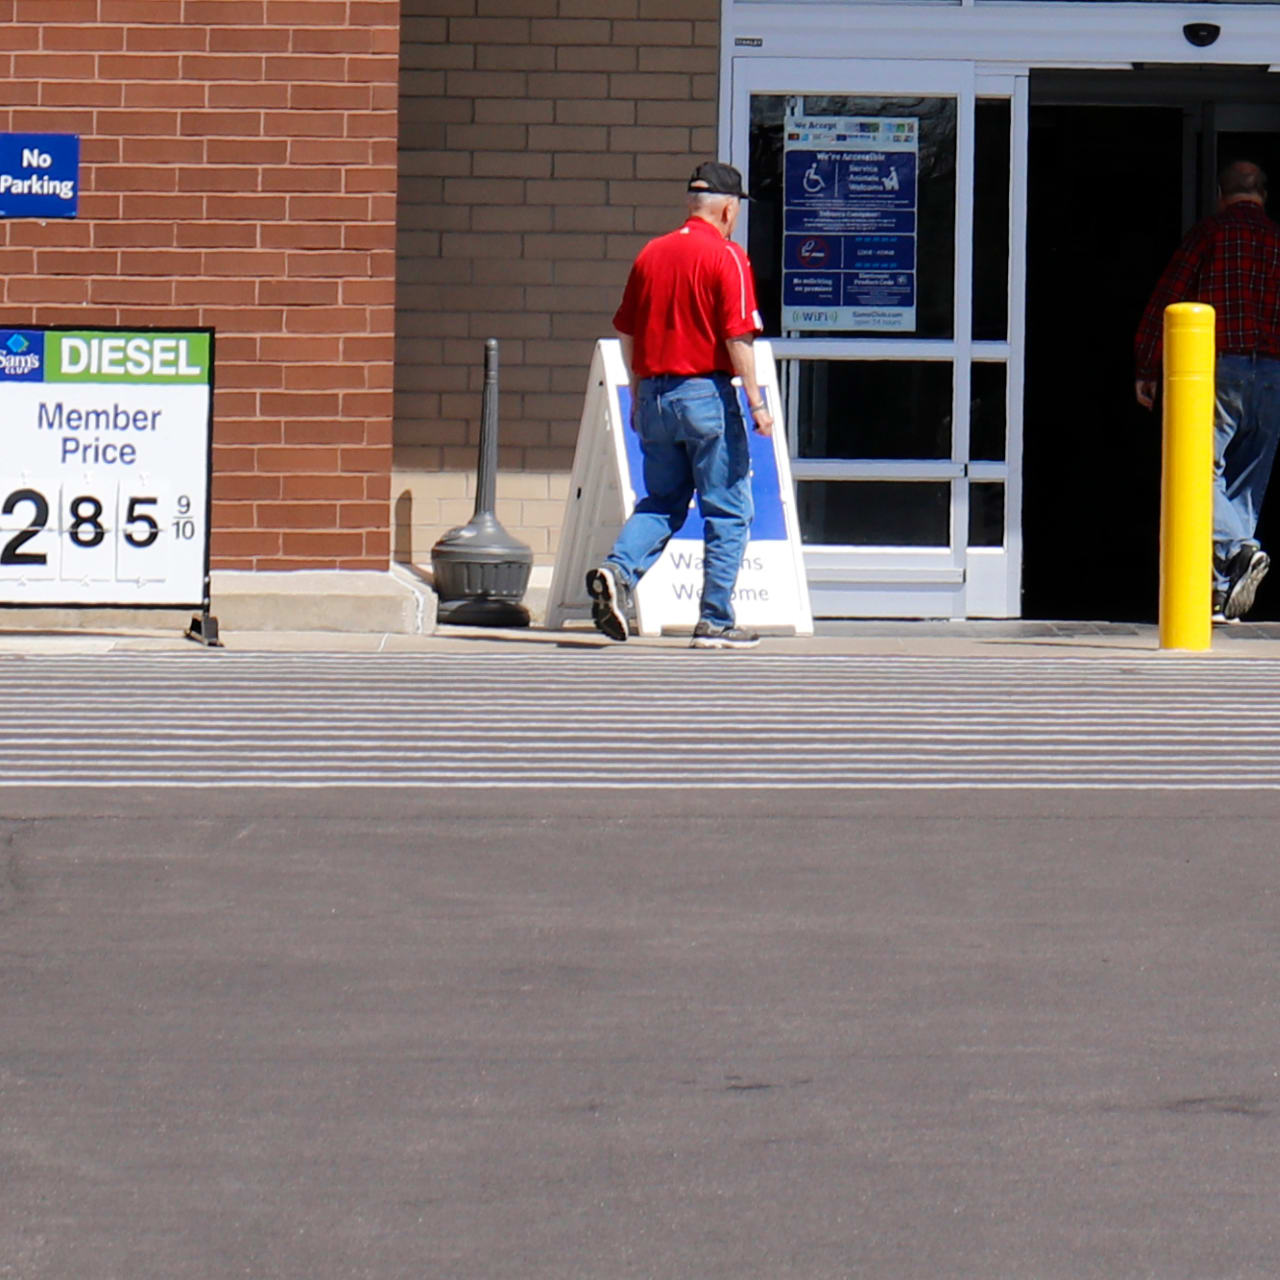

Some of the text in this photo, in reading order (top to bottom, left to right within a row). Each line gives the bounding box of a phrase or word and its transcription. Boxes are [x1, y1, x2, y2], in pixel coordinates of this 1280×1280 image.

[22, 148, 52, 168] No
[0, 174, 75, 199] Parking
[60, 338, 202, 376] DIESEL
[37, 402, 162, 431] Member
[60, 437, 137, 465] Price
